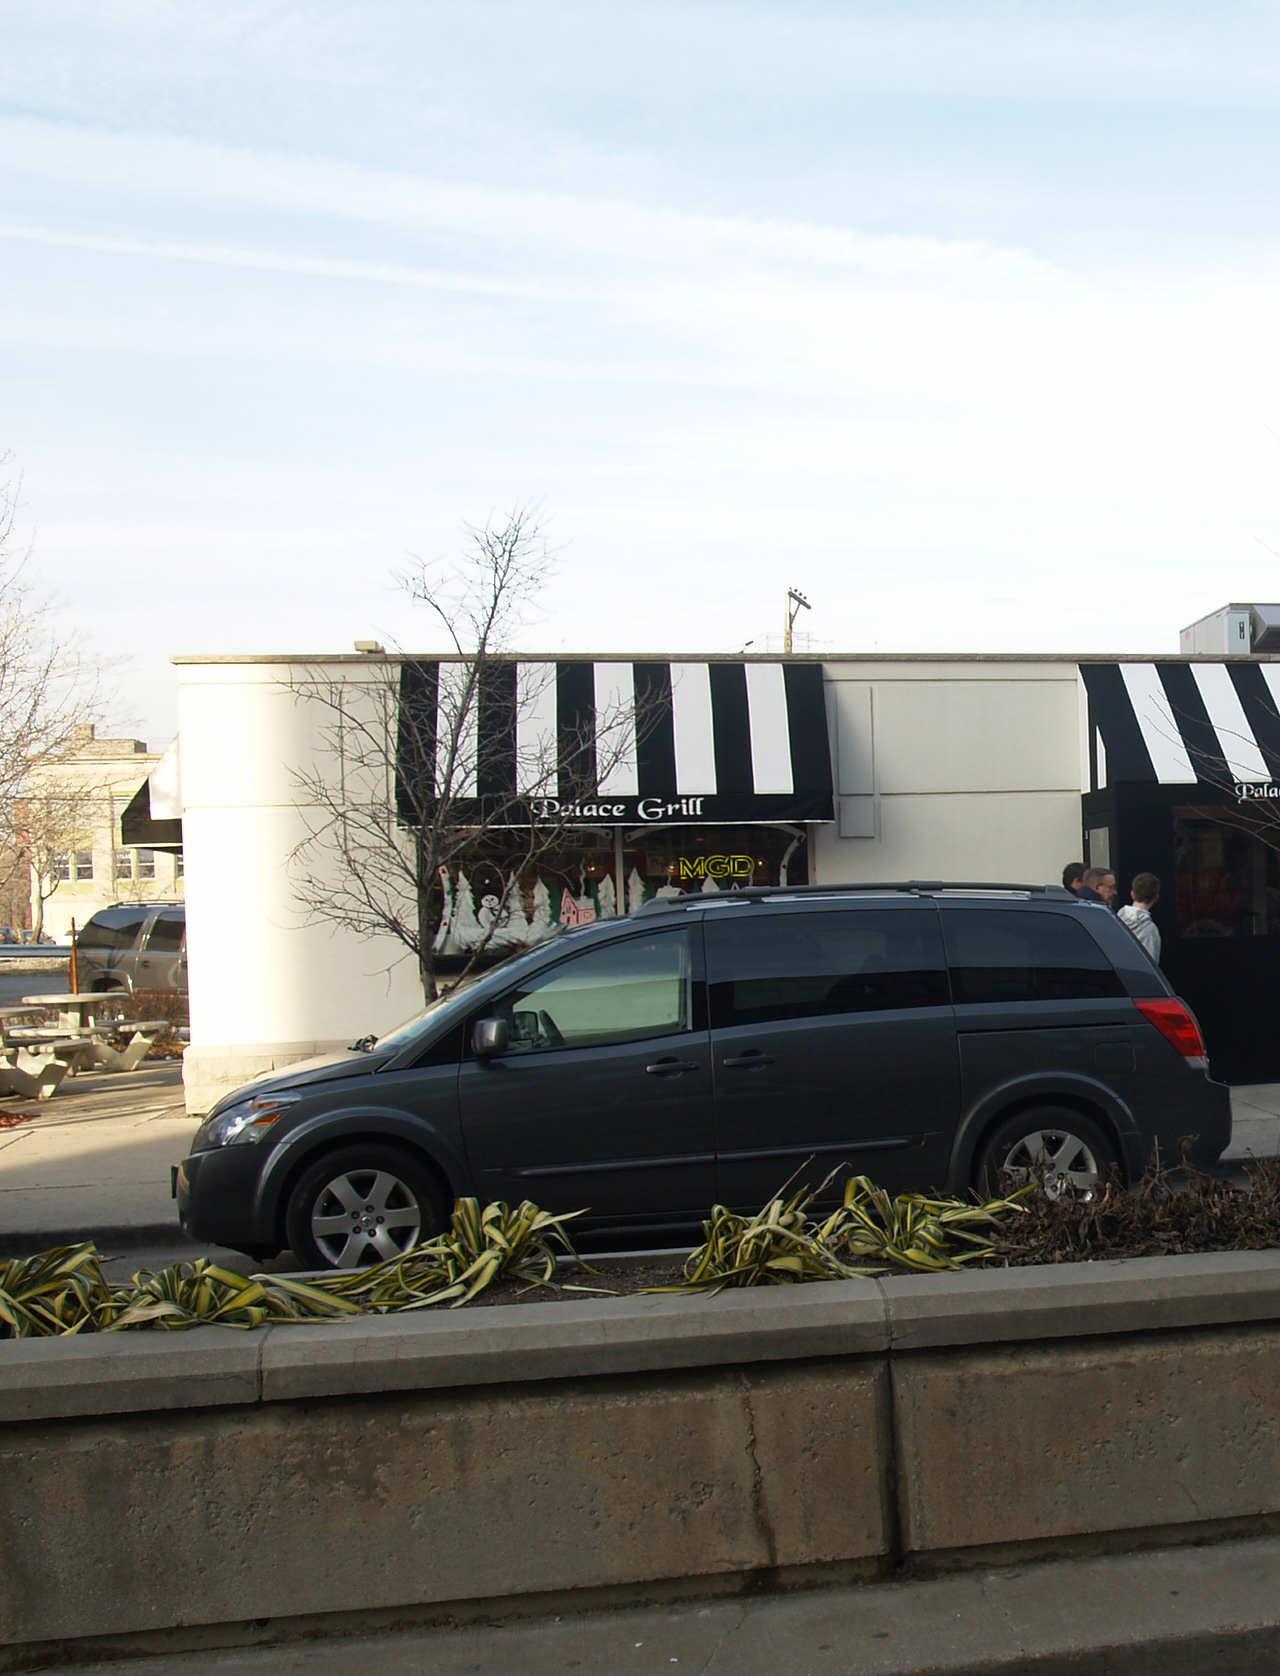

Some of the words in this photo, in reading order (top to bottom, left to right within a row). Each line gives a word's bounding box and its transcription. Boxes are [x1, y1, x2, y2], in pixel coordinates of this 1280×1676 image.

[530, 798, 626, 819] Palace
[637, 796, 705, 820] Grill
[678, 854, 757, 880] MGD
